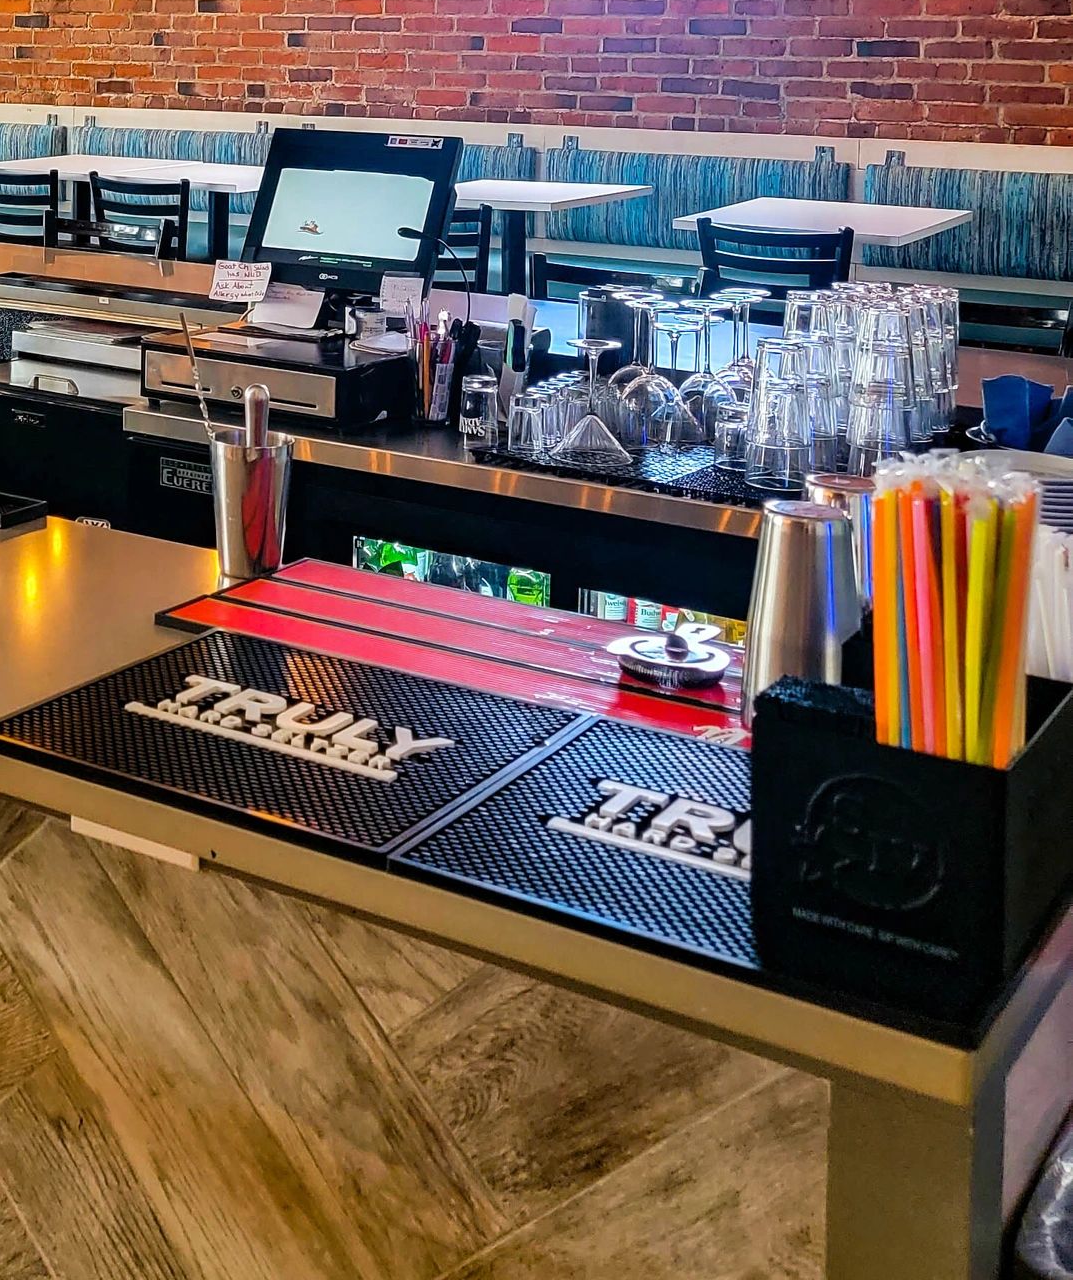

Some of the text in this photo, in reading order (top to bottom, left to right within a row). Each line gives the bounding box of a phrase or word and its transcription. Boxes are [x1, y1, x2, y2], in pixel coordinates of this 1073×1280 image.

[219, 263, 236, 271] Goat
[215, 282, 229, 290] Ask
[157, 697, 243, 730] HARD
[176, 674, 455, 762] TRULY
[584, 812, 697, 853] HARD
